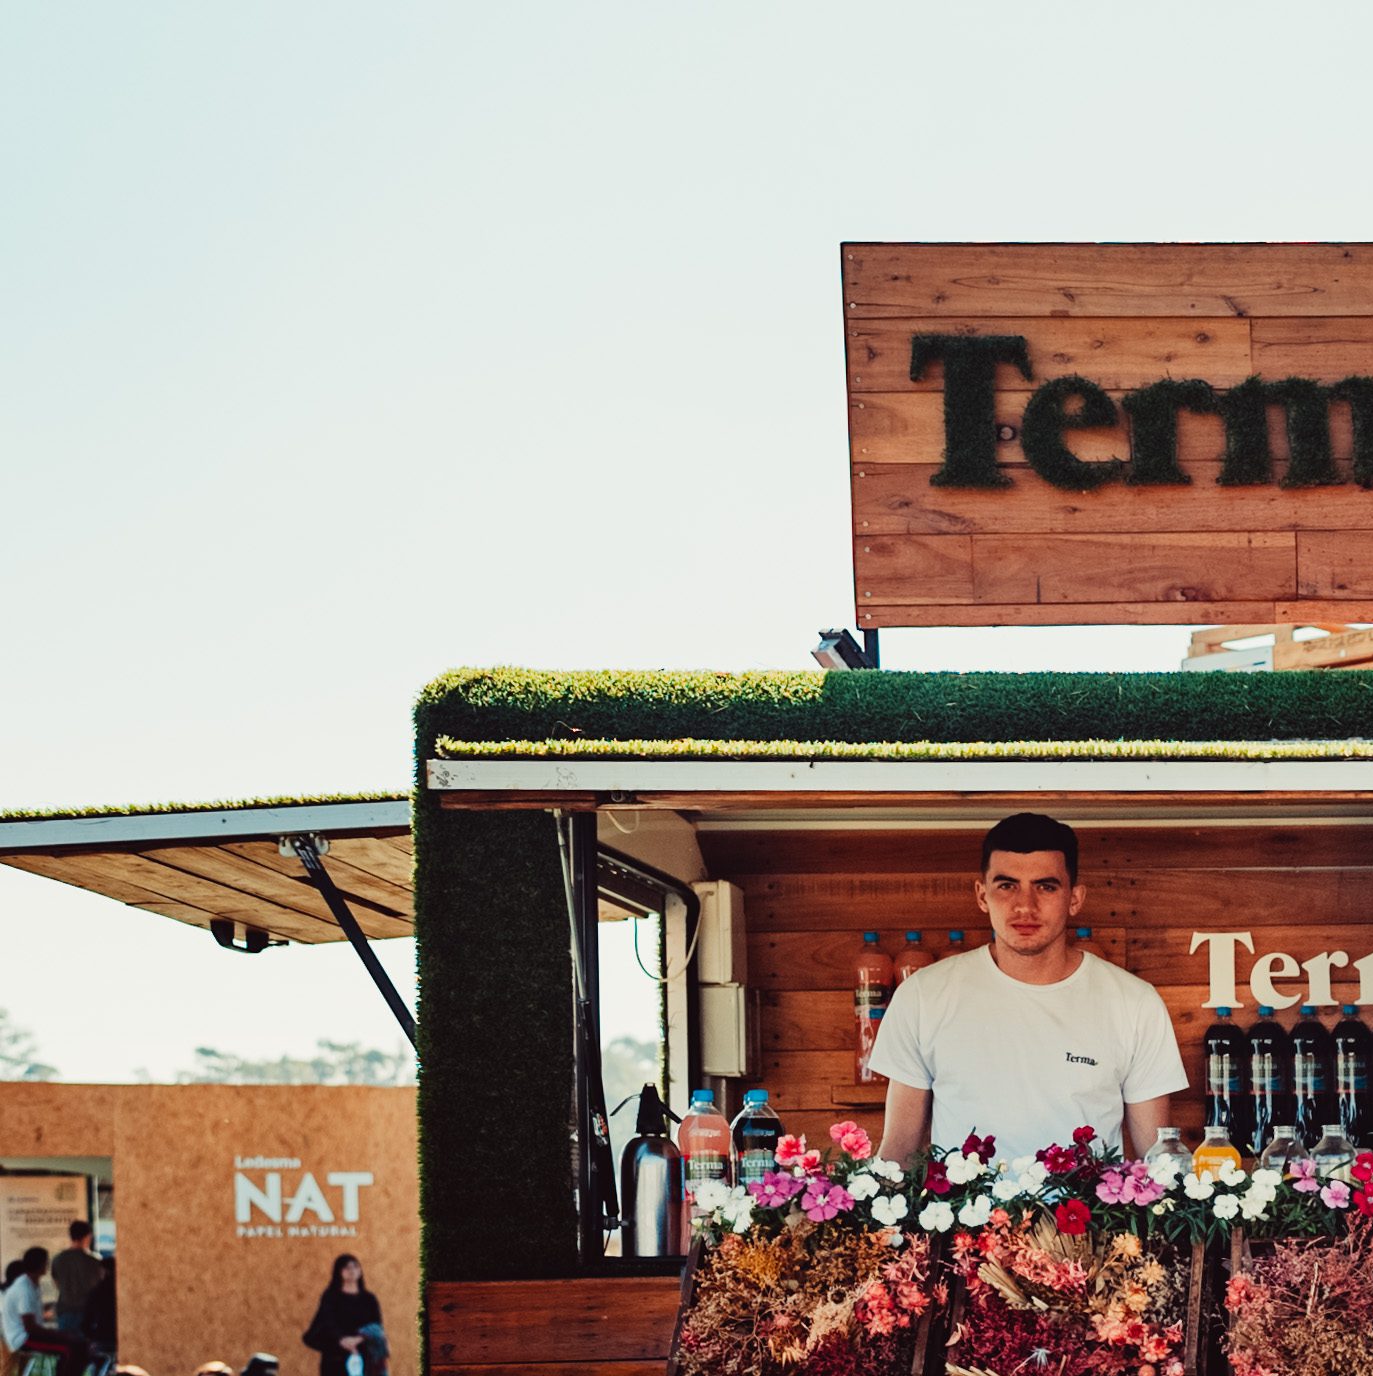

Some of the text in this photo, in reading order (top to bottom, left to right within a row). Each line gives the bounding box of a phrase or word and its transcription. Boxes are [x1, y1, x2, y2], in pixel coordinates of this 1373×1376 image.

[1066, 1052, 1096, 1066] Terma
[689, 1159, 724, 1170] Terma
[741, 1158, 775, 1168] Terma
[235, 1171, 374, 1224] NAT
[236, 1225, 358, 1238] PAPEL NATURAL
